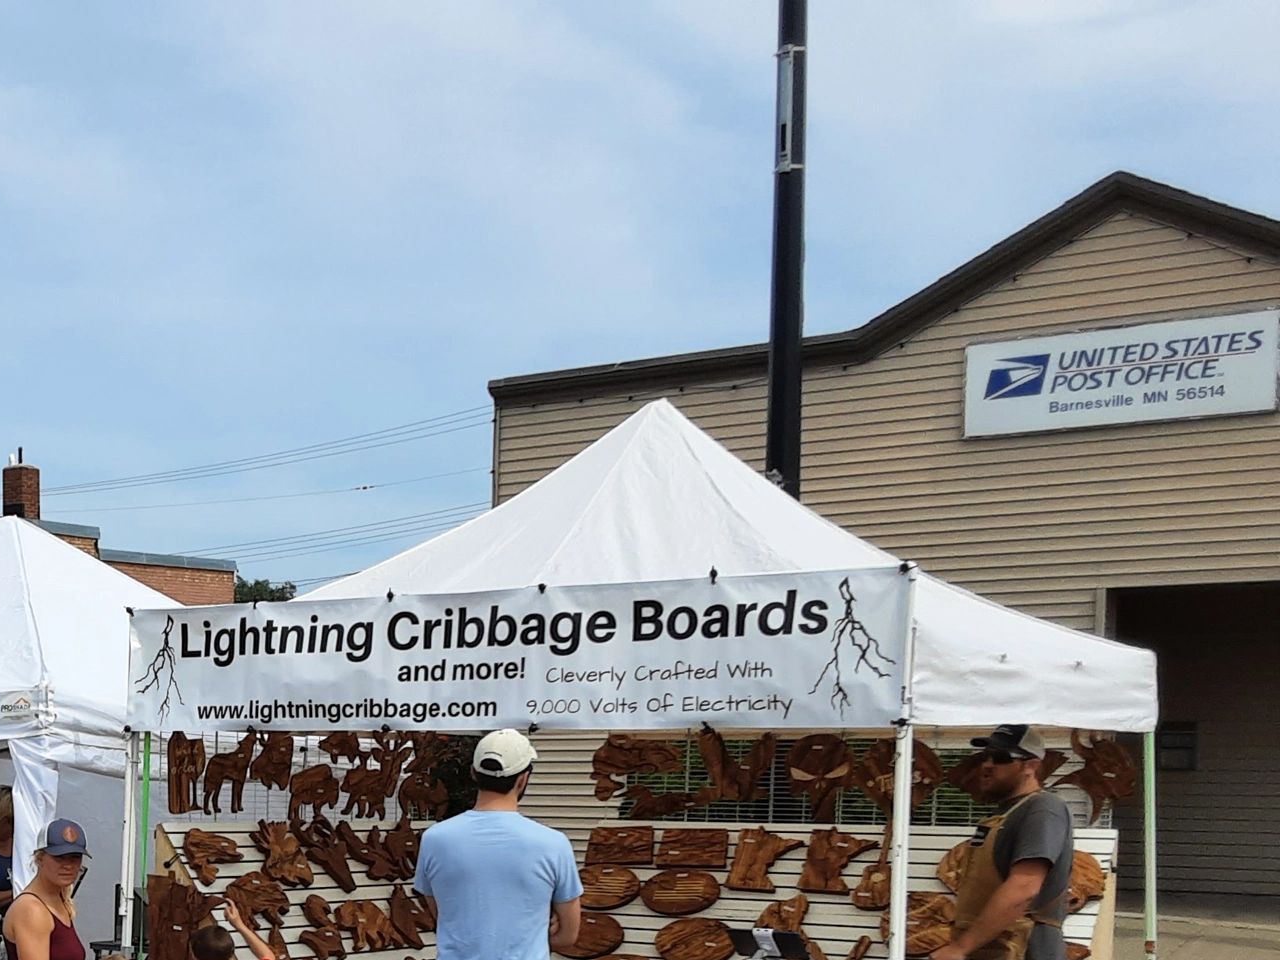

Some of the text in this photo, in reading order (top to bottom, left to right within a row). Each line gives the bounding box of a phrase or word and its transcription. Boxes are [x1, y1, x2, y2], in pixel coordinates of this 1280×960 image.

[1058, 330, 1265, 371] UNITED STATES
[1050, 358, 1219, 394] POST OFFICE
[1049, 385, 1226, 414] Barnesville MN 56514
[180, 589, 829, 667] Lightning Cribbage Boards
[397, 656, 526, 683] and more!
[545, 659, 773, 691] Cleverly Crafted With
[0, 703, 31, 713] PROSHAD
[197, 698, 498, 724] www.lightningcribbage.com
[525, 692, 794, 720] 9,000 Volts Of Electricity
